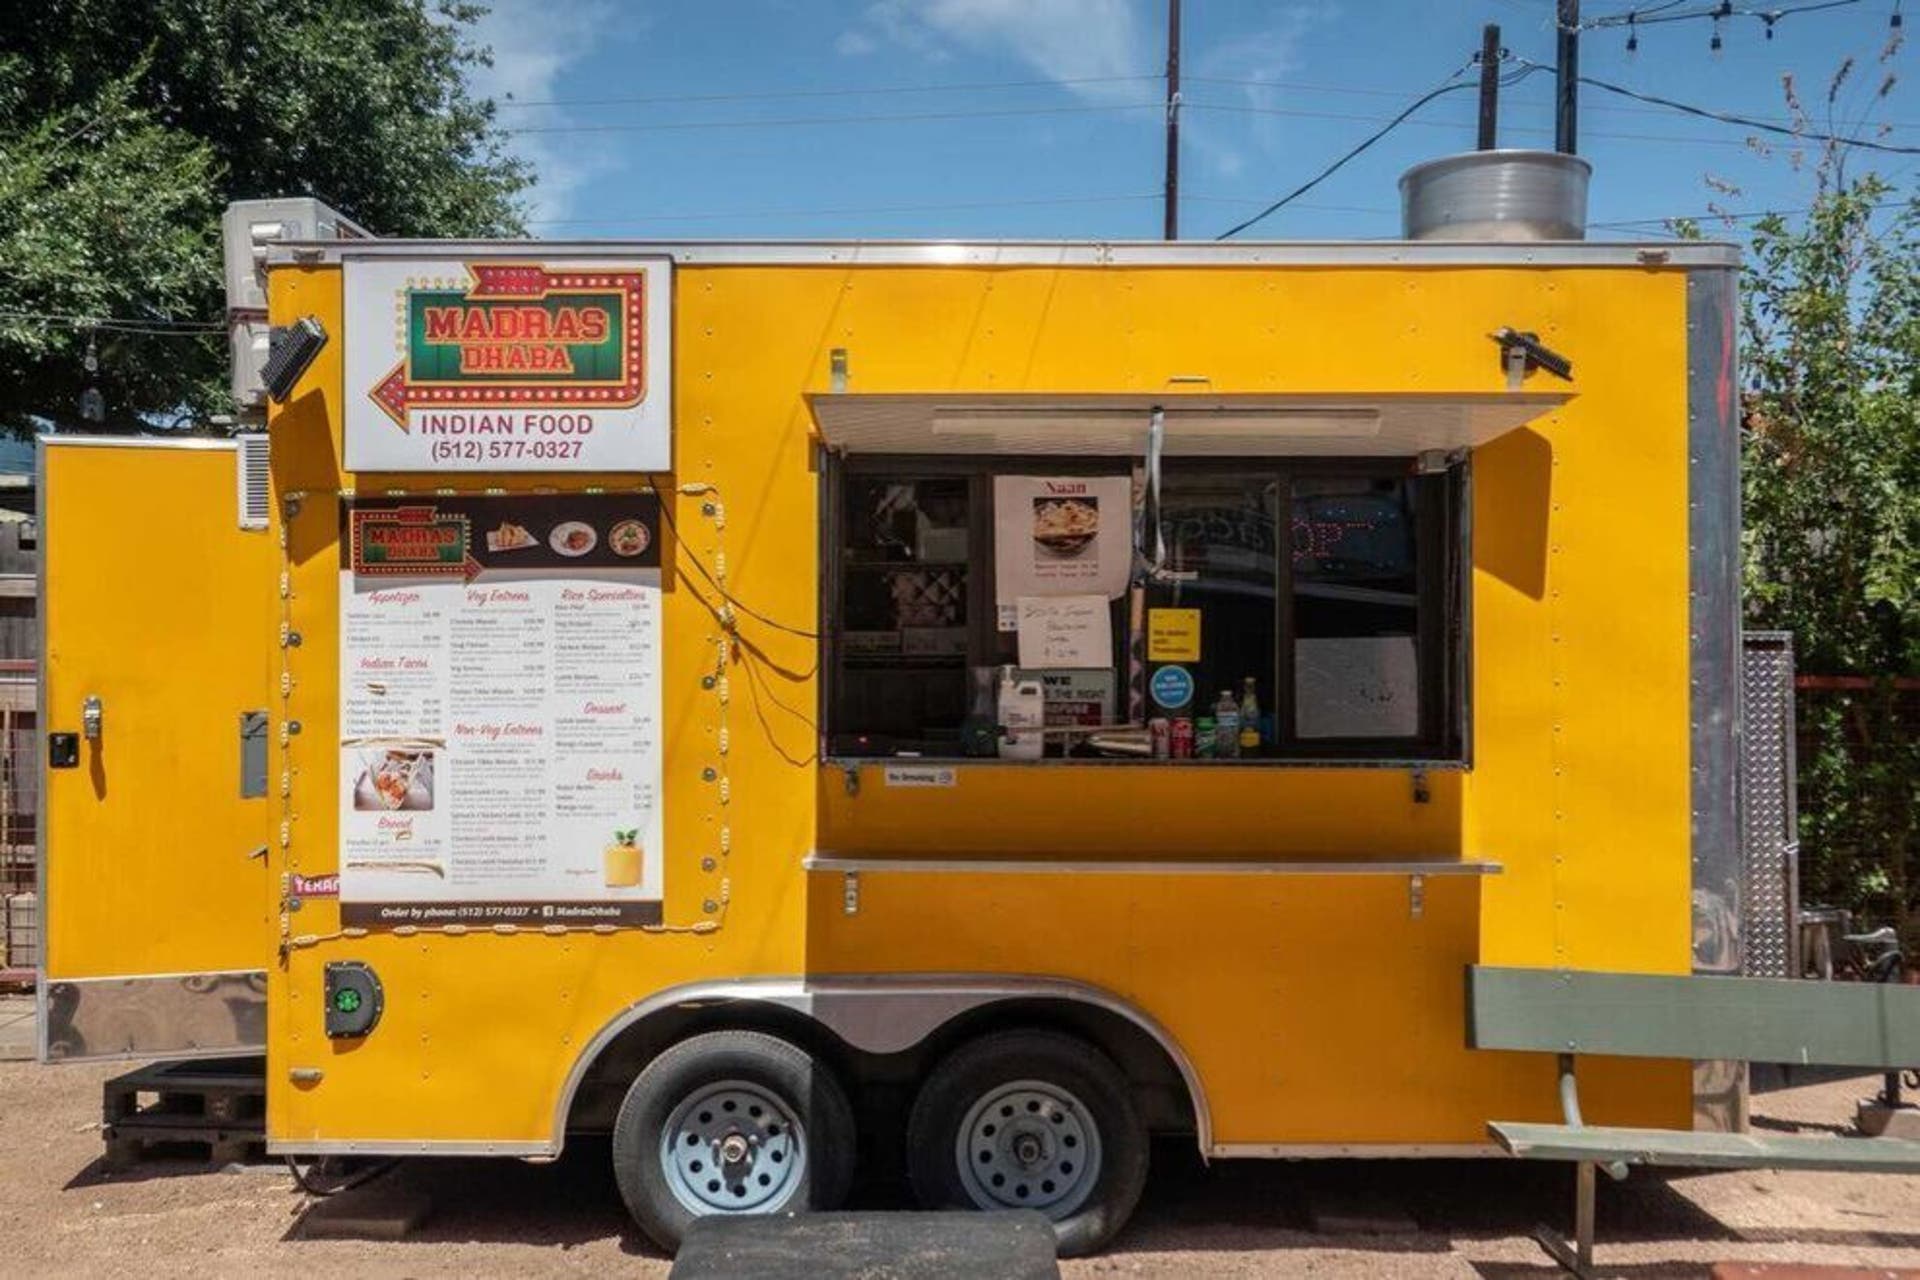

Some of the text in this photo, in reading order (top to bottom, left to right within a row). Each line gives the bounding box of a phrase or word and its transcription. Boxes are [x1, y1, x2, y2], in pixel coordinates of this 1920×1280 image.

[426, 308, 607, 341] MADRAS
[462, 346, 573, 373] DHABA
[421, 414, 593, 435] INDIAN FOOD
[431, 441, 583, 462] (512) 577-0327
[1045, 481, 1087, 495] Naan
[370, 527, 457, 544] MADRAS
[467, 590, 488, 606] Veg
[561, 588, 584, 601] Rice
[360, 656, 395, 668] Indian
[1043, 676, 1071, 685] WE
[381, 907, 410, 918] Order
[411, 907, 423, 919] by
[458, 906, 483, 918] (512)
